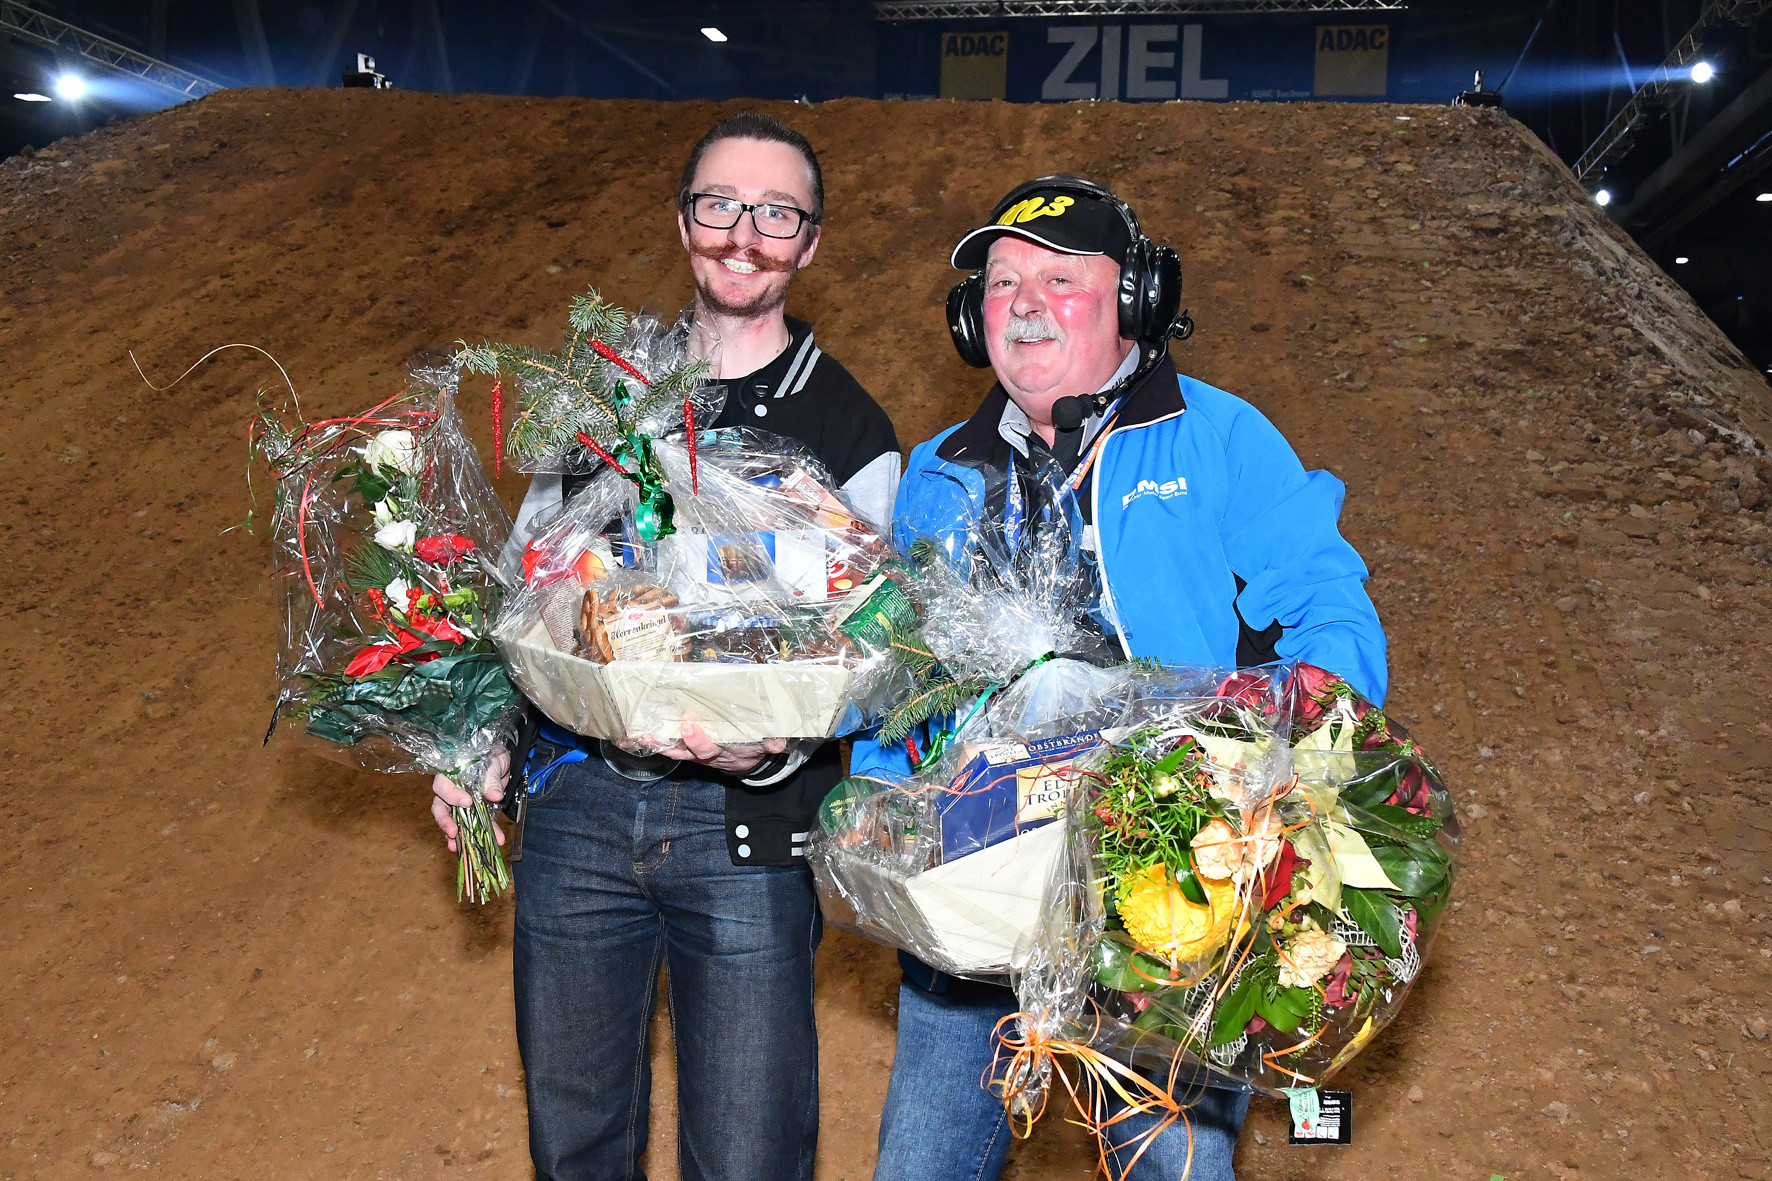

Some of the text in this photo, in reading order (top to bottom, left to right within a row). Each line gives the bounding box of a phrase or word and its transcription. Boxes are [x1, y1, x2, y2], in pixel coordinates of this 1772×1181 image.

[945, 35, 1005, 57] ADAC
[1319, 27, 1386, 52] ADAC
[1041, 24, 1229, 99] ZIEL
